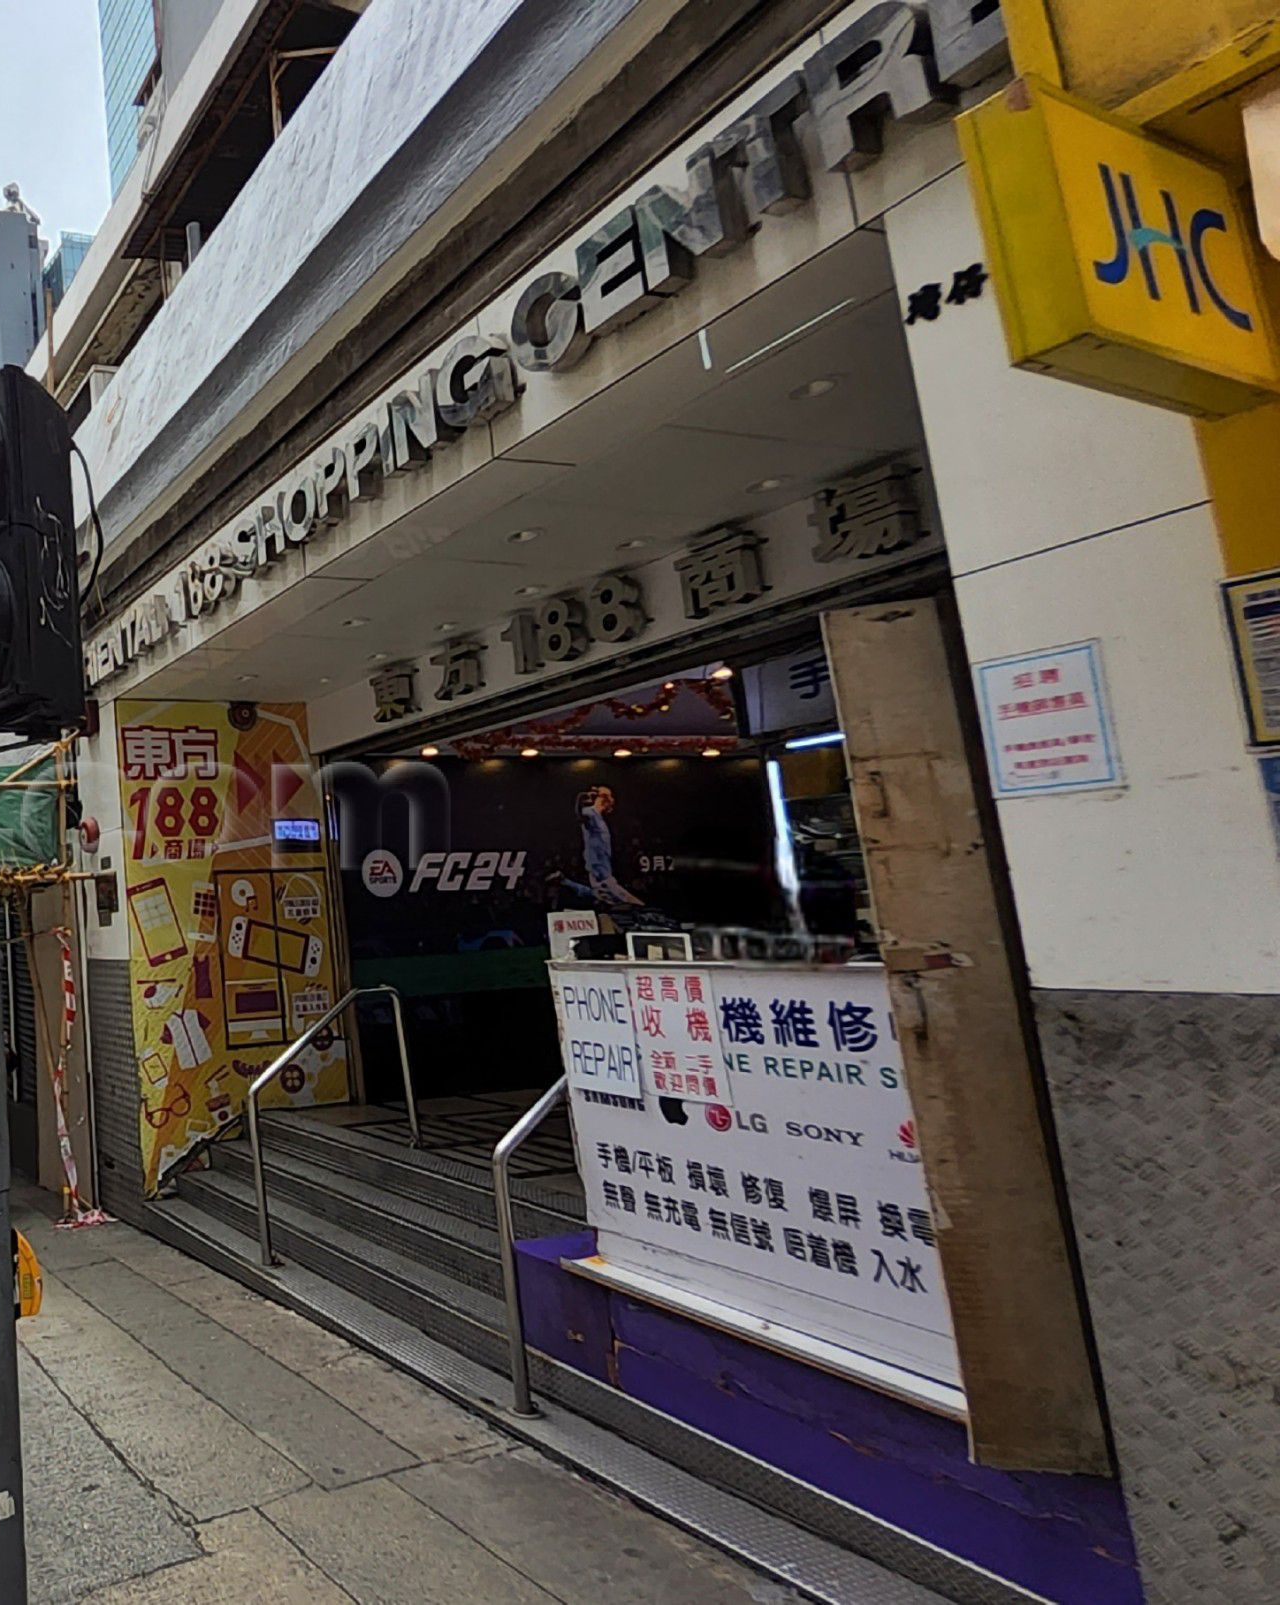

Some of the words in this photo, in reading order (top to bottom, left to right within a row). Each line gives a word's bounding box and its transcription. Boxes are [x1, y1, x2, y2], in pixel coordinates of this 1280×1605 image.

[1092, 161, 1254, 333] JHC
[231, 335, 515, 577] SHOPPING
[121, 726, 218, 780] 東方
[129, 786, 220, 860] 188
[164, 839, 206, 860] 商場
[370, 860, 396, 876] EA
[563, 986, 628, 1025] PHONE
[636, 975, 705, 1004] 超高價
[720, 997, 898, 1053] 機維修
[571, 1040, 636, 1083] REPAIR
[764, 1056, 867, 1087] REPAIR
[735, 1110, 769, 1135] LG
[785, 1121, 865, 1148] SONY
[870, 1248, 928, 1294] 入水
